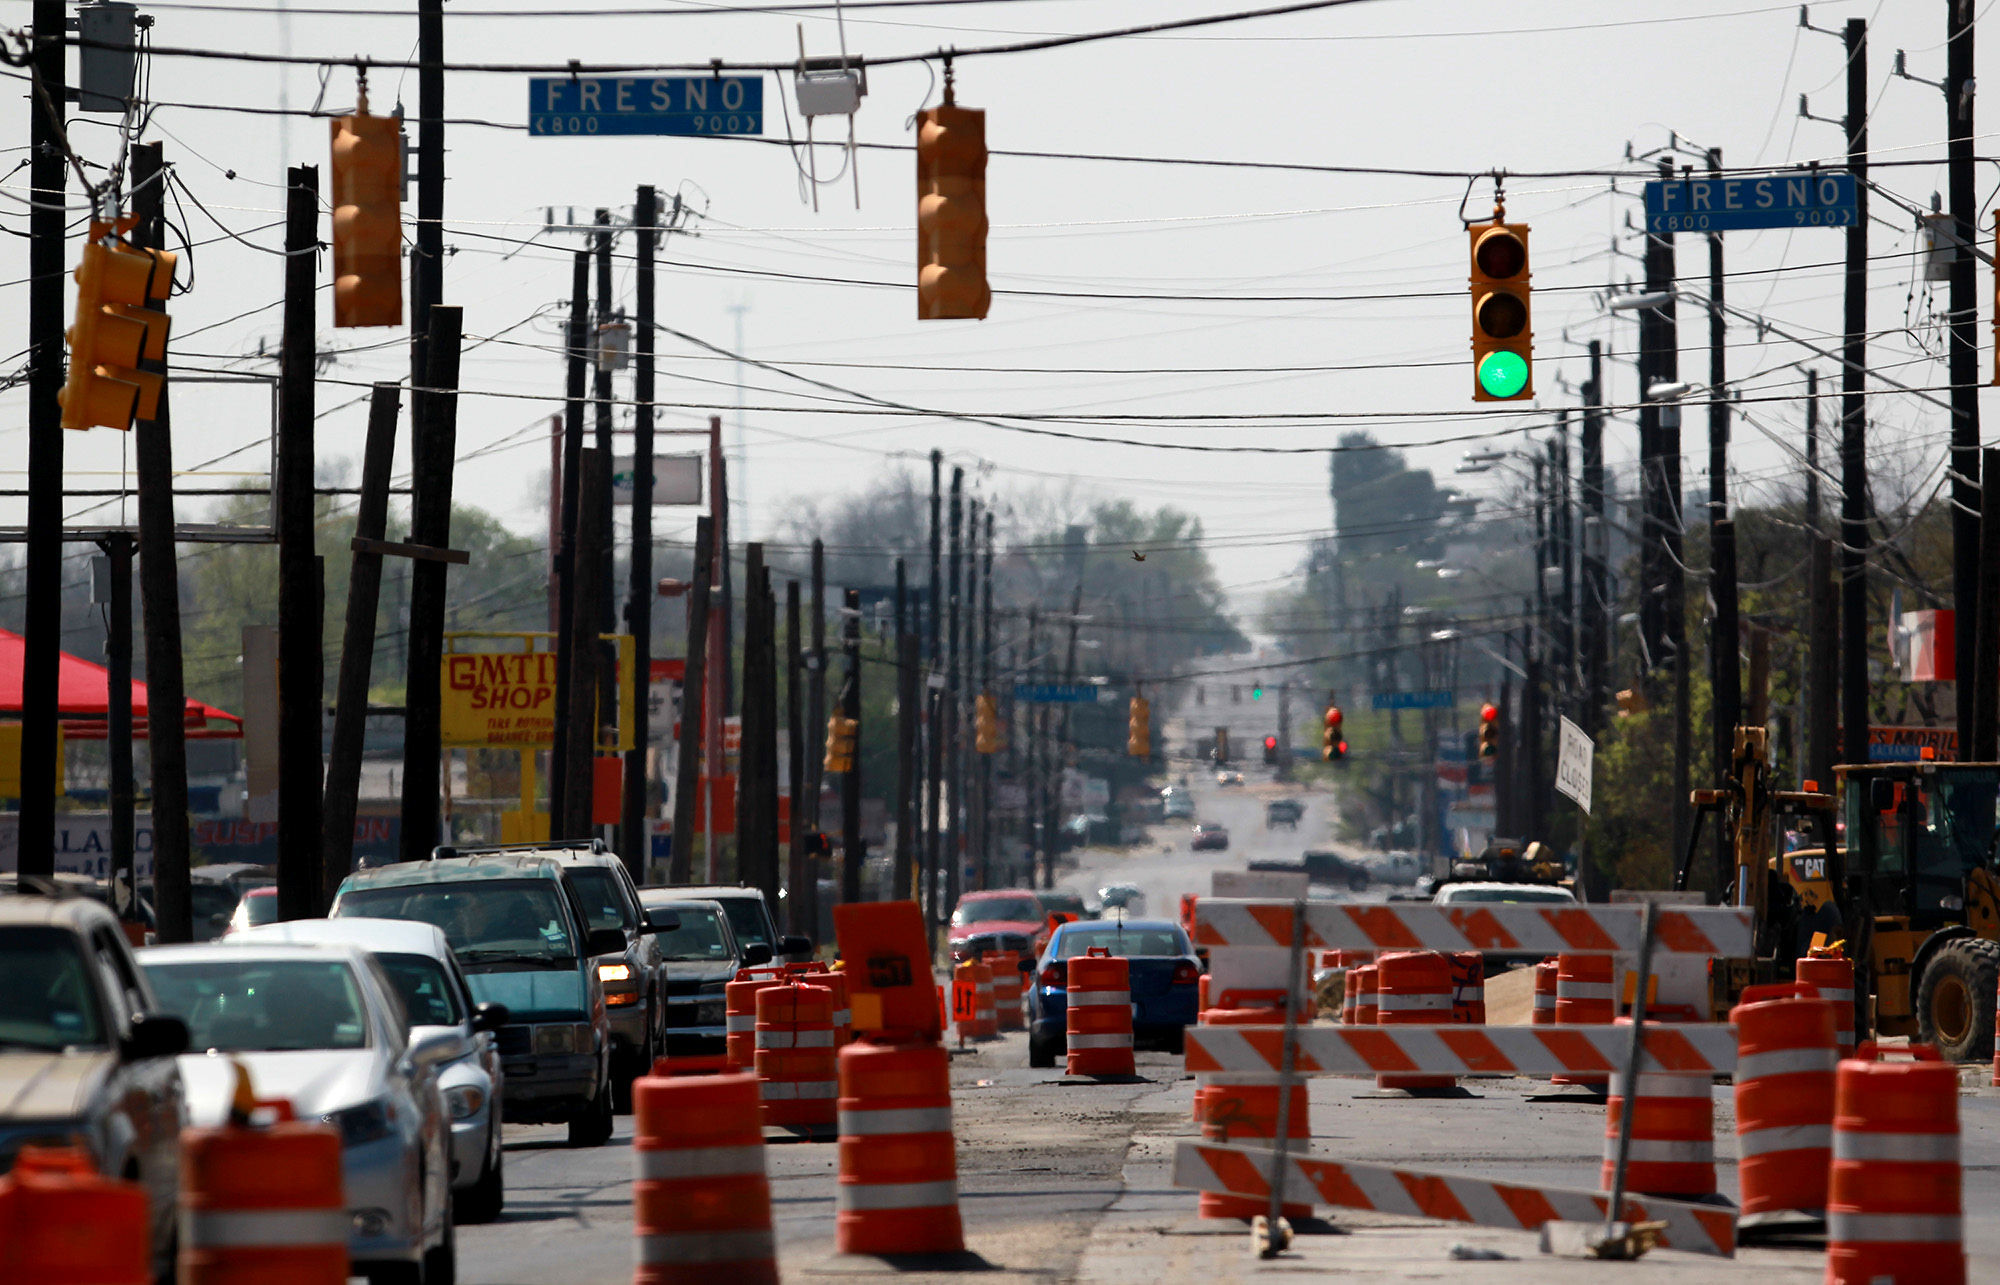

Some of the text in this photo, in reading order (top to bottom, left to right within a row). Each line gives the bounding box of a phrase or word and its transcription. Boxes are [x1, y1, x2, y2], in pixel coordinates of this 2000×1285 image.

[547, 79, 744, 111] FRESNO
[551, 116, 740, 133] 800 900
[1662, 178, 1839, 211] FRESNO
[1668, 210, 1837, 230] 800 900
[471, 685, 552, 709] SHOP
[1561, 760, 1589, 800] CLOSED
[1805, 858, 1825, 880] CAT
